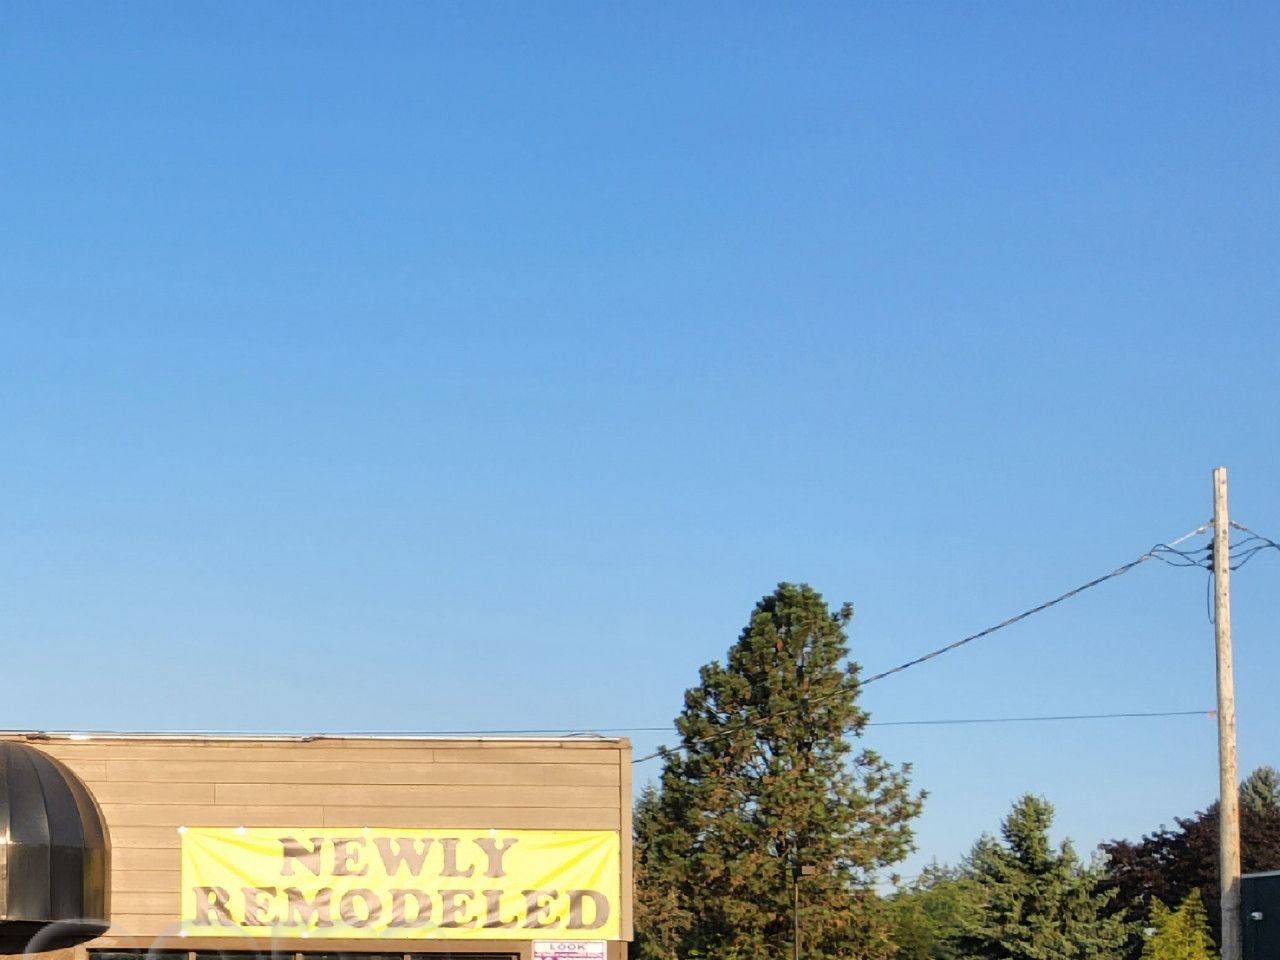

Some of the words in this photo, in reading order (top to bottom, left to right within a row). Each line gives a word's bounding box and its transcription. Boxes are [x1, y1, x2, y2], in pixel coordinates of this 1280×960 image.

[278, 836, 519, 878] NEWLY
[192, 886, 610, 931] REMODELED
[549, 943, 586, 951] LOOK
